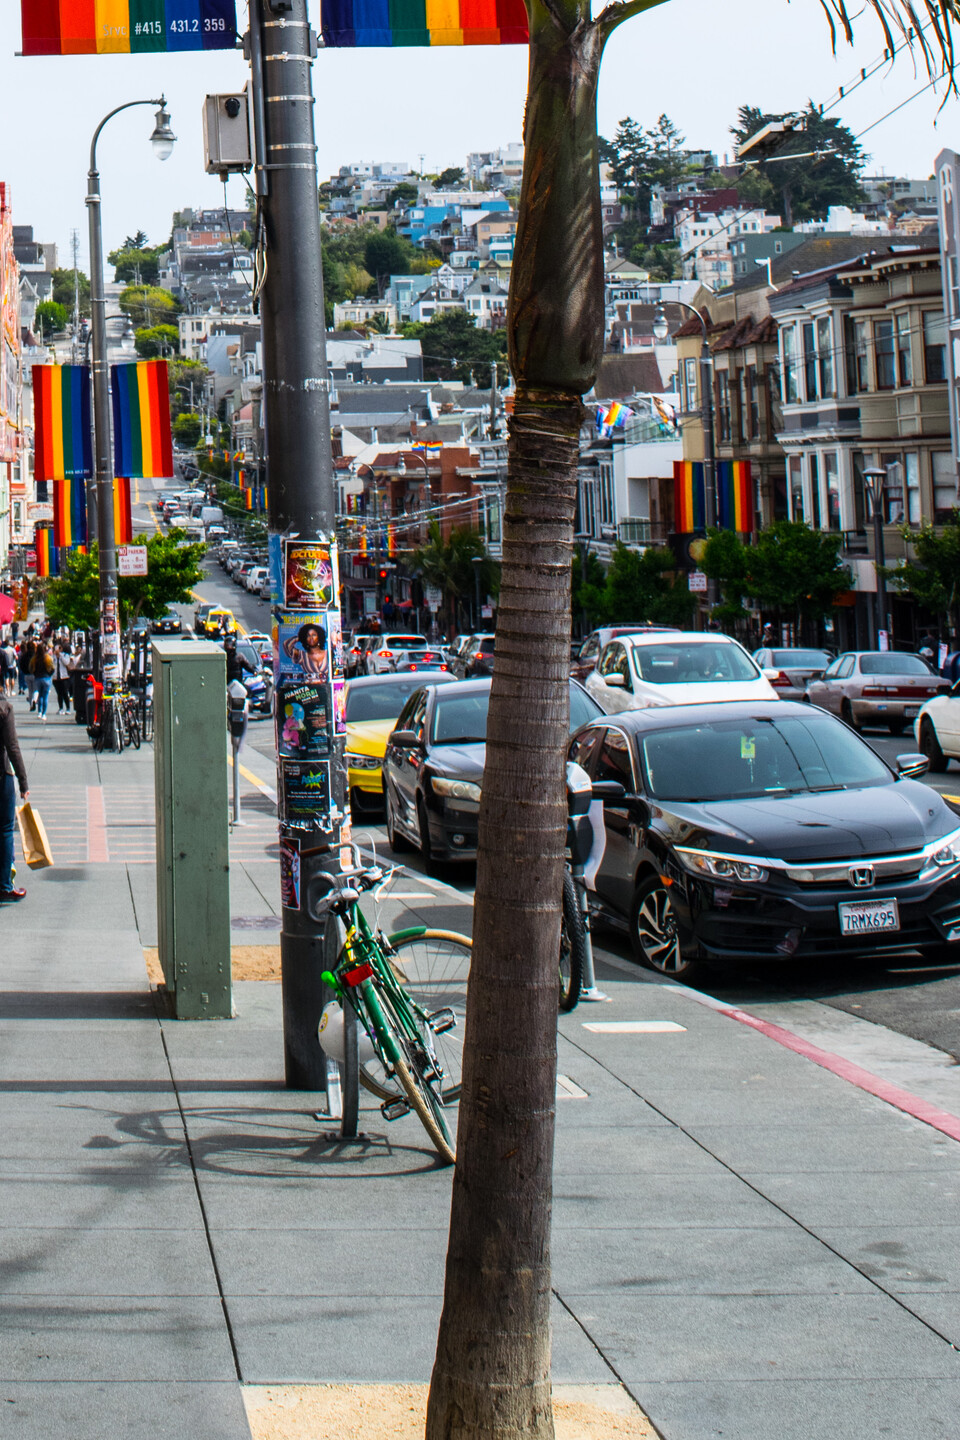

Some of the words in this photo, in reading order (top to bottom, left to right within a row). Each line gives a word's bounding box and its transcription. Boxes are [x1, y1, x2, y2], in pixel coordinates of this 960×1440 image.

[103, 24, 127, 36] Srvc
[134, 21, 162, 35] #415
[170, 19, 199, 32] 431.2
[204, 18, 226, 31] 359
[844, 911, 895, 929] 7RMX695
